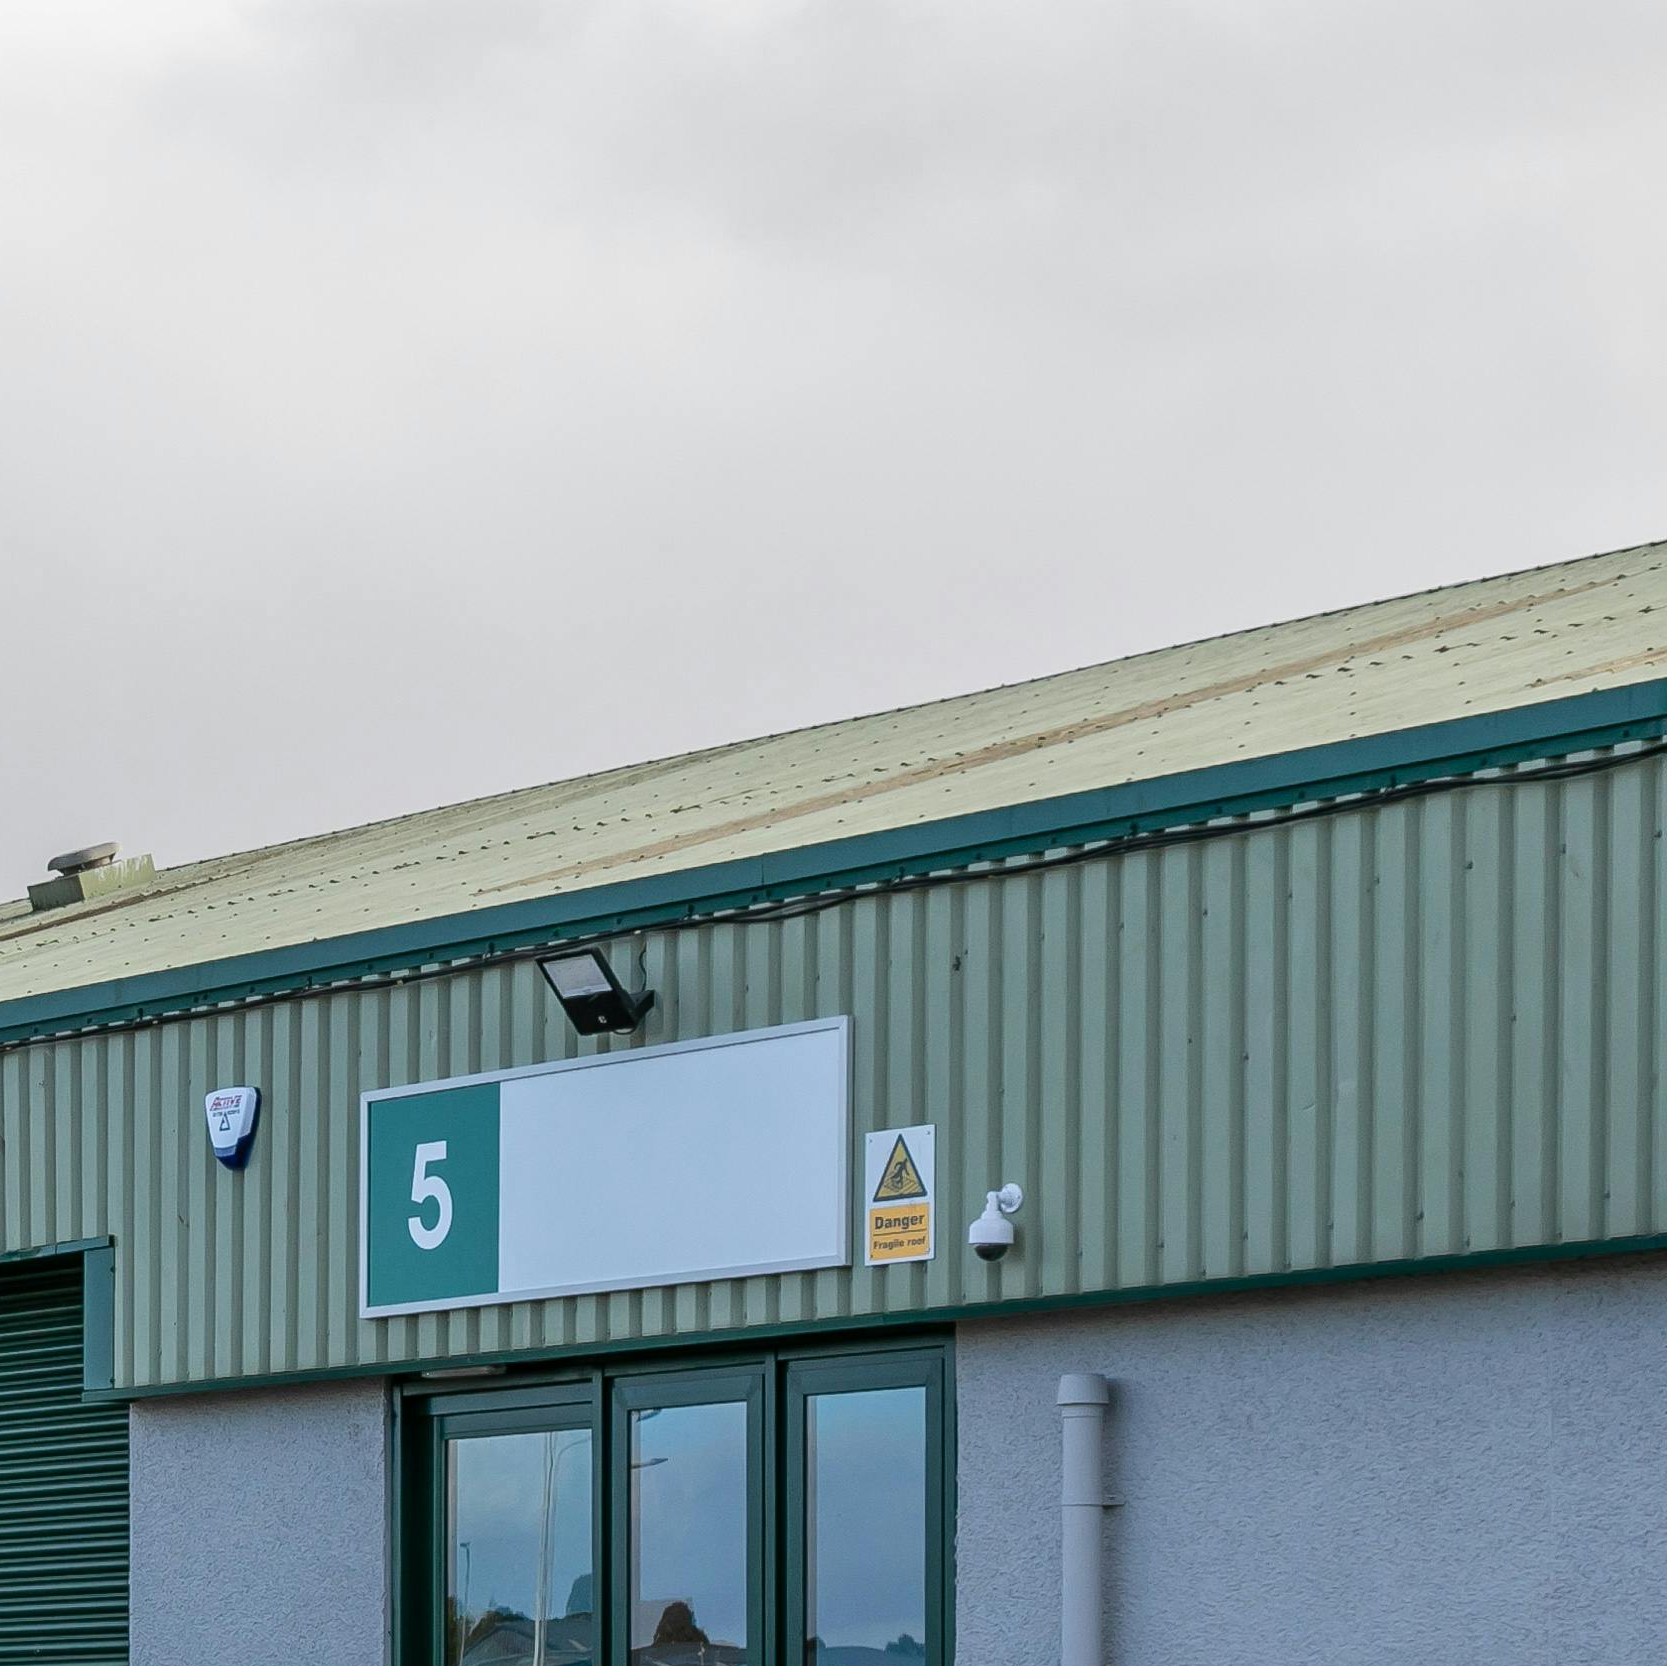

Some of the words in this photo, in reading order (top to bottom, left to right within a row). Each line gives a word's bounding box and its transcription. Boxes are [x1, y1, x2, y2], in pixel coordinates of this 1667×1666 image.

[407, 1140, 453, 1250] 5
[874, 1214, 925, 1229] Danger
[873, 1239, 905, 1250] Fragile
[907, 1236, 926, 1246] roof
